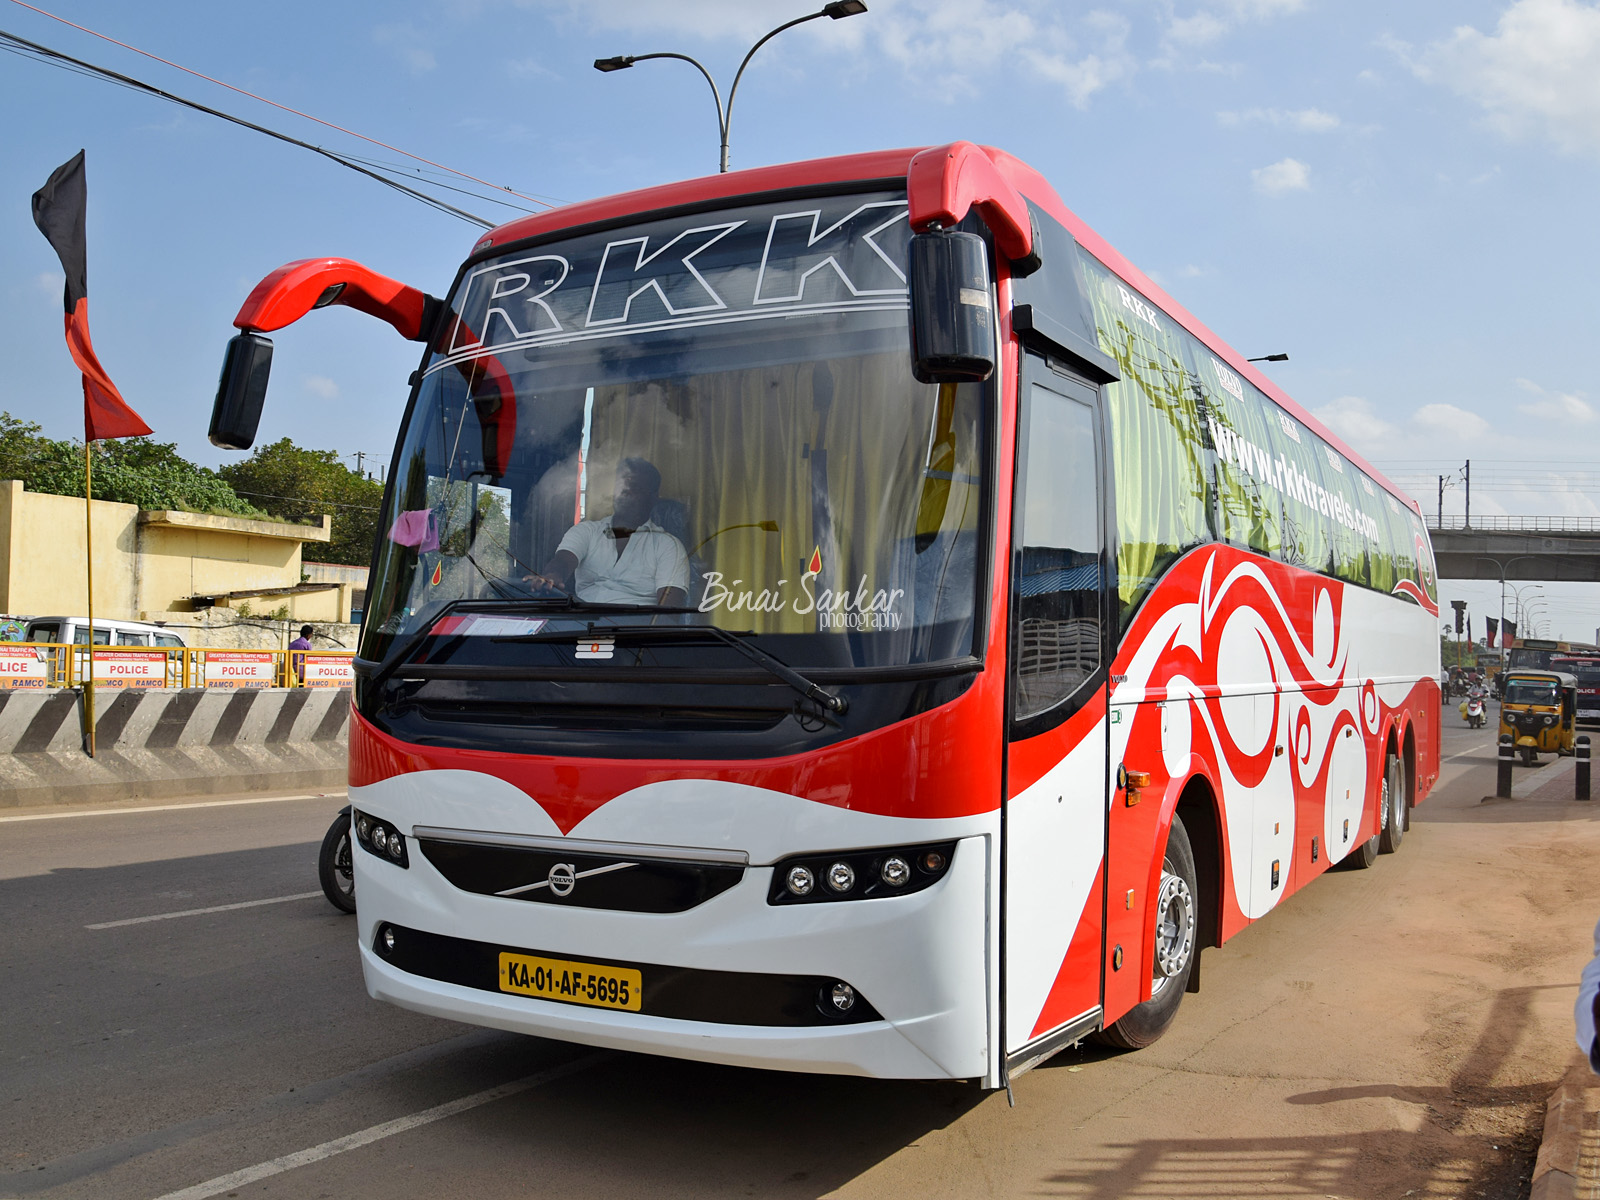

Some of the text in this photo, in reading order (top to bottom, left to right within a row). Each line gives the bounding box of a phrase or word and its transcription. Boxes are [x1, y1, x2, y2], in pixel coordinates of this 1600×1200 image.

[1117, 284, 1161, 332] RKK
[1207, 416, 1379, 543] www.rkktravels.com
[0, 662, 28, 672] LICE
[110, 665, 148, 674] POLICE
[222, 667, 256, 675] POLICE
[318, 668, 348, 676] POLICE
[550, 876, 573, 884] VOLVO
[508, 961, 630, 1006] KA-01-AF-5695
